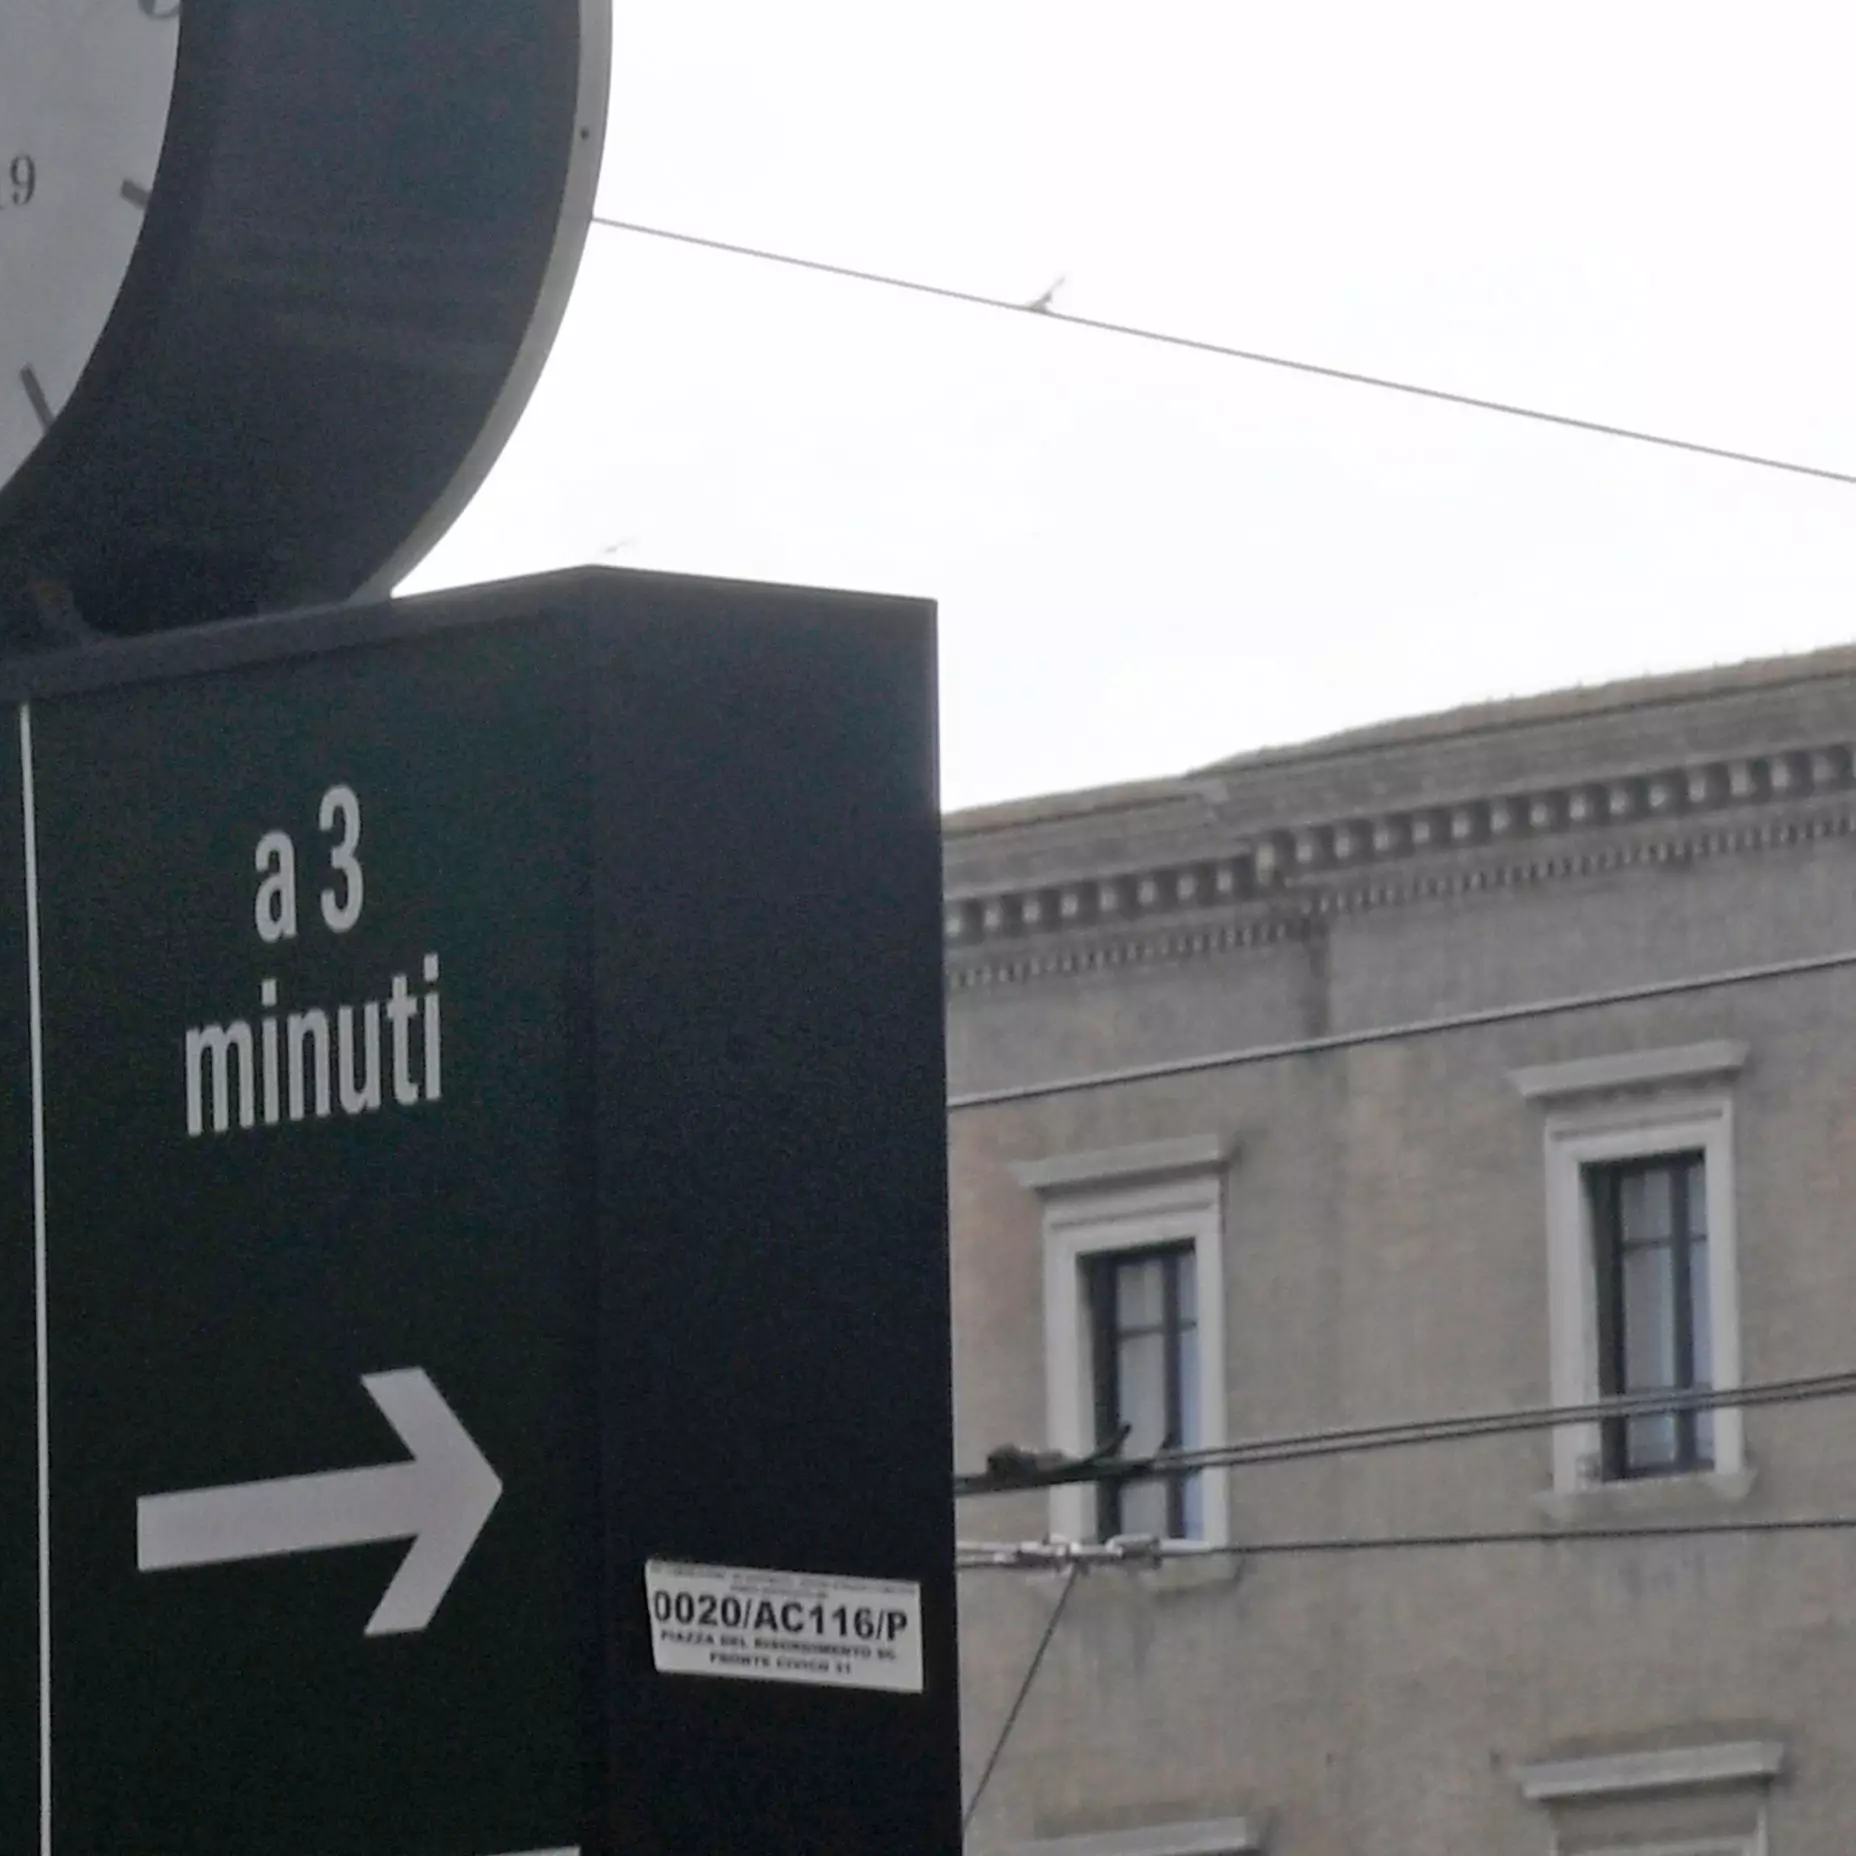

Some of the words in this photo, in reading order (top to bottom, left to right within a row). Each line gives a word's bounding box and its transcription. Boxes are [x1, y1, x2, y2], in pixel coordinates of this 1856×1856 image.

[254, 830, 297, 942] a
[319, 785, 364, 934] 3
[186, 953, 442, 1136] minuti
[654, 1590, 908, 1642] 0020/AC116/P
